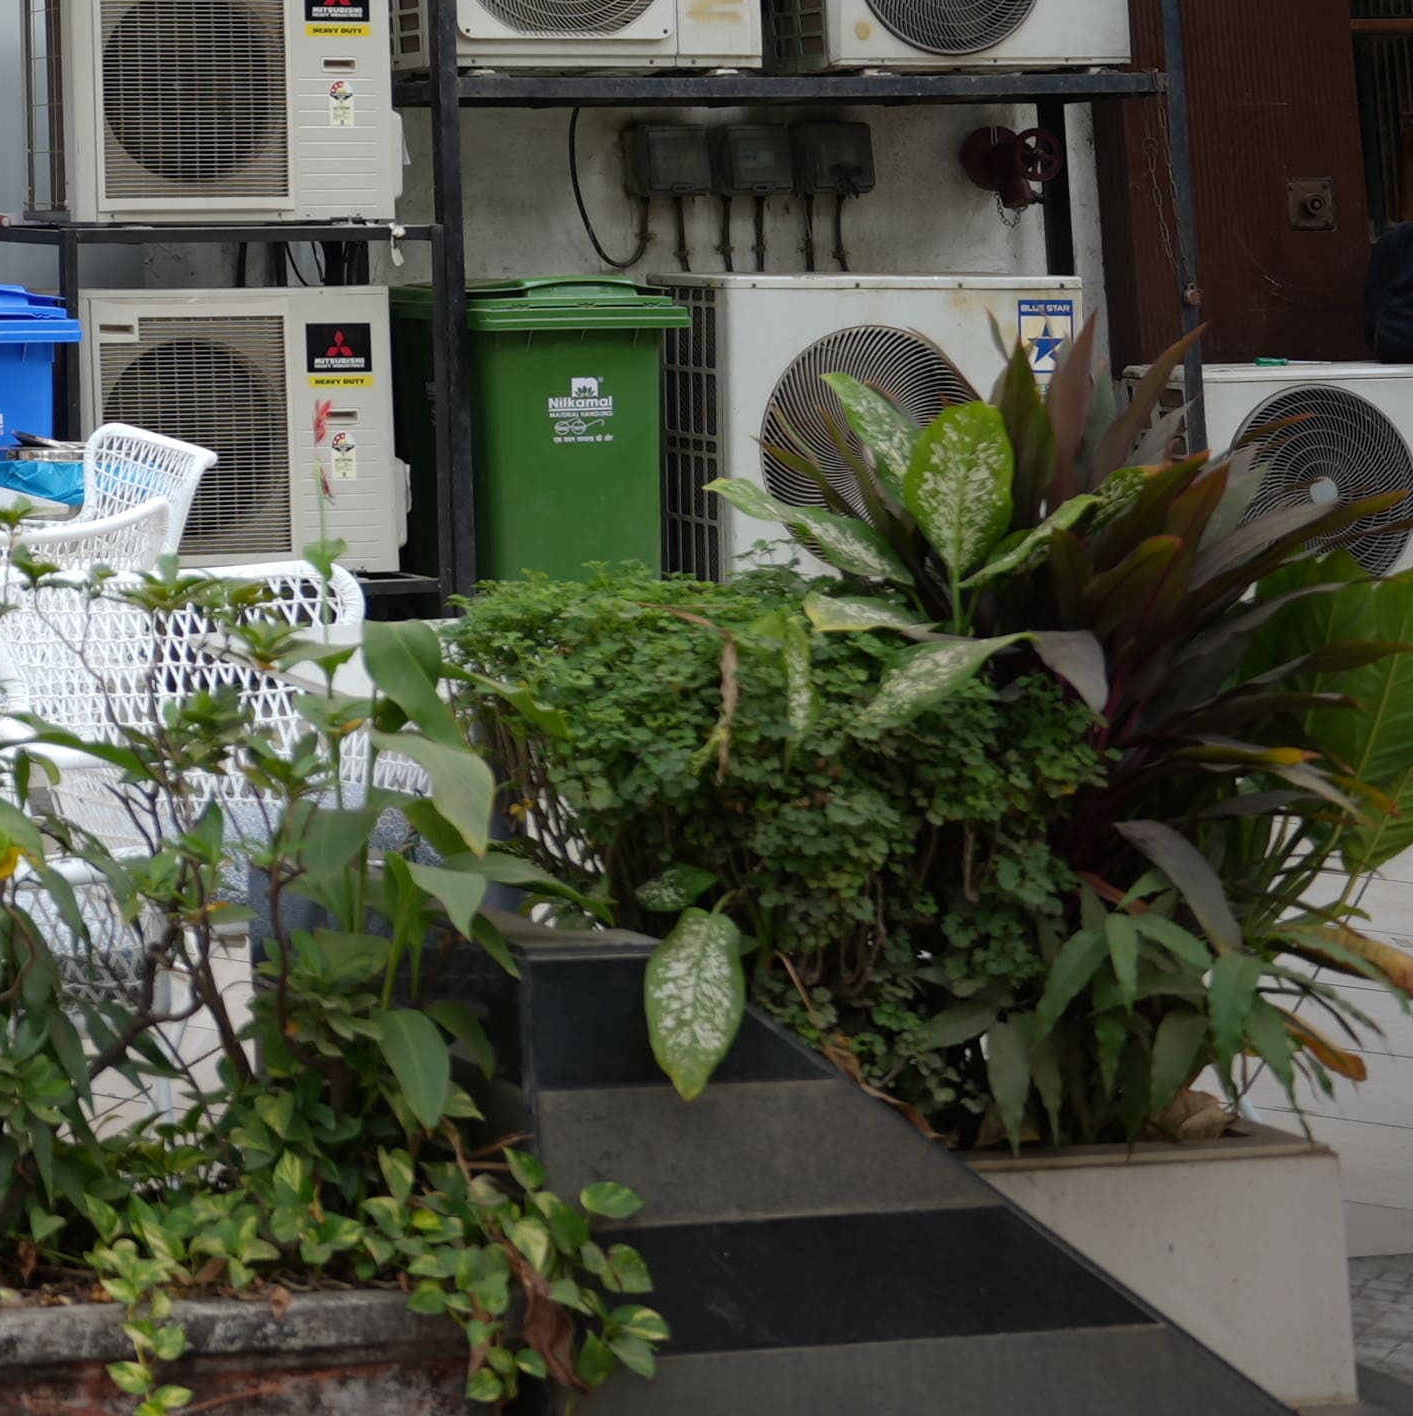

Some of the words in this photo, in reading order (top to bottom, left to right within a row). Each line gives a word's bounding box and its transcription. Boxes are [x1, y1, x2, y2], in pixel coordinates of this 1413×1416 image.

[312, 6, 363, 14] MITSUBISHI
[1046, 304, 1070, 312] STAR
[314, 357, 365, 365] MITSUBISHI
[548, 395, 613, 409] Nilkamal
